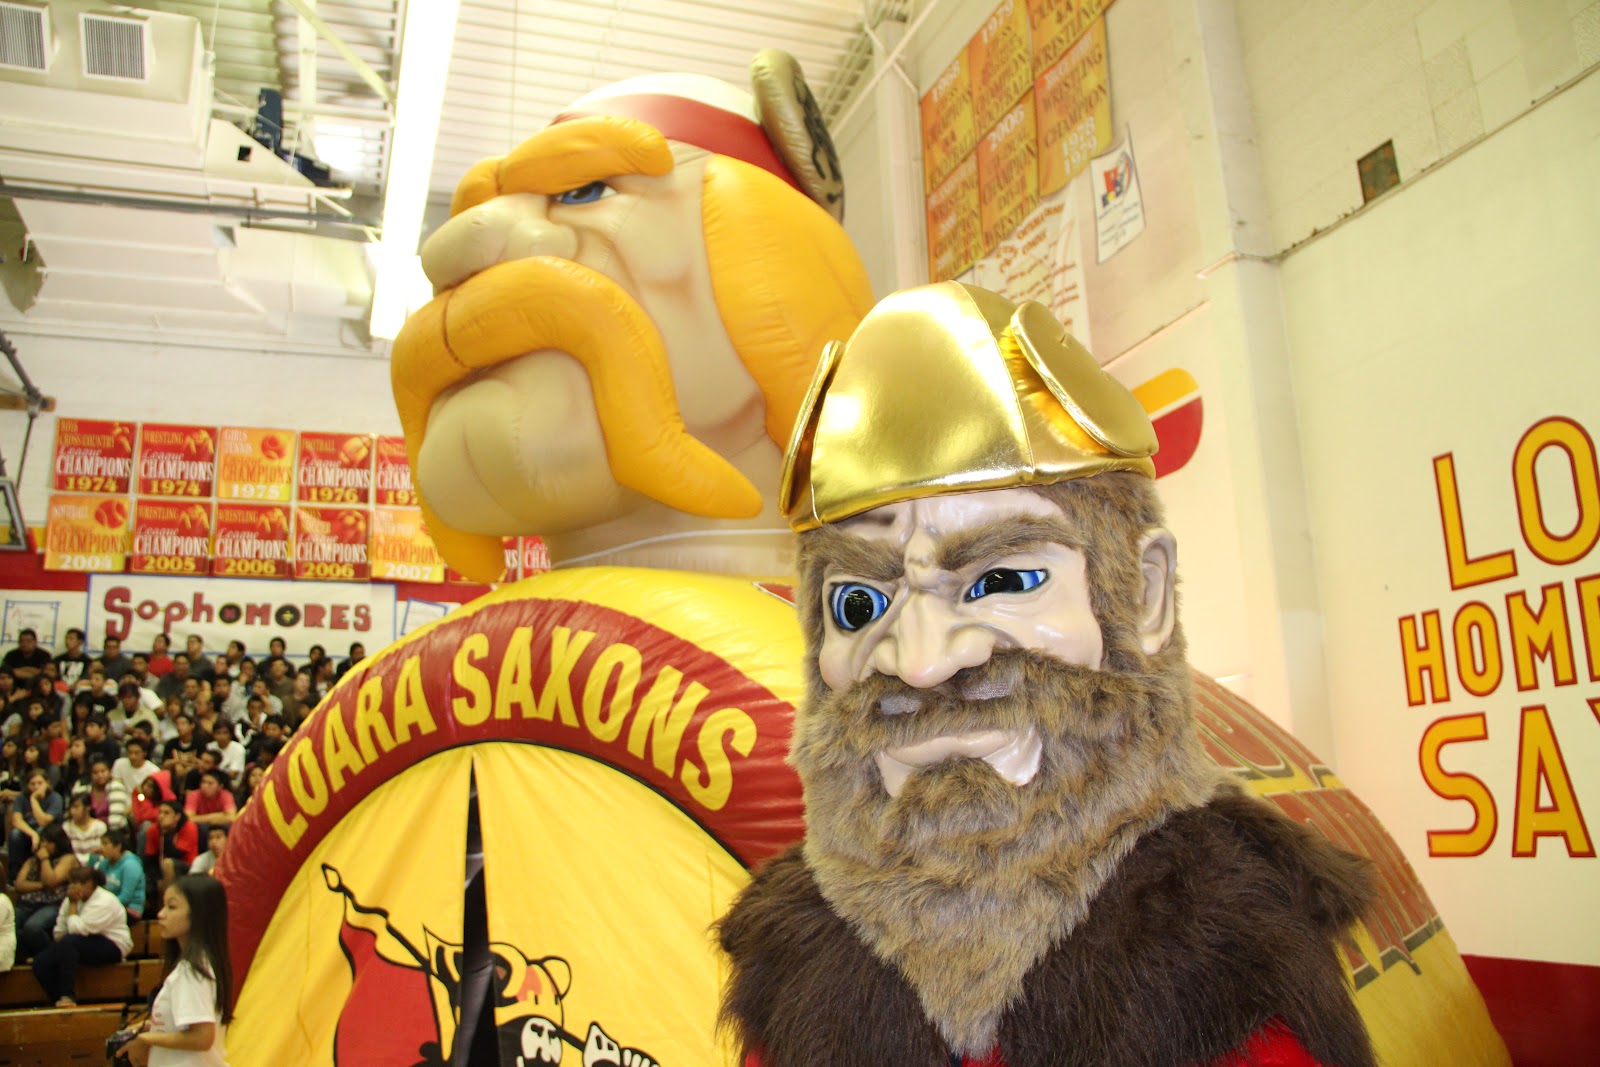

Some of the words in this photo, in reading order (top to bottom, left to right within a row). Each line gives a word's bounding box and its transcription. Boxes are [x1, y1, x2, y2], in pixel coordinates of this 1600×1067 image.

[1062, 116, 1096, 158] 1978
[58, 433, 81, 446] CROSS
[82, 435, 115, 448] COUNTRY
[144, 430, 184, 444] WRESTLING
[223, 428, 248, 442] GIRLS
[58, 445, 102, 456] League
[142, 449, 184, 460] League
[56, 455, 132, 478] CHAMPIONS
[140, 459, 214, 481] CHAMPIONS
[222, 463, 292, 483] CHAMPIONS
[66, 476, 118, 492] 1974
[300, 466, 370, 488] CHAMPIONS
[150, 480, 201, 496] 1974
[230, 484, 281, 499] 1975
[309, 486, 359, 503] 1976
[138, 505, 178, 520] WRESTLING
[218, 509, 258, 524] WRESTLING
[136, 524, 180, 536] League
[216, 527, 259, 540] League
[50, 533, 126, 554] CHAMPIONS
[134, 534, 209, 556] CHAMPIONS
[216, 538, 290, 560] CHAMPIONS
[296, 541, 368, 564] CHAMPIONS
[58, 554, 113, 570] 2004
[143, 556, 197, 571] 2005
[224, 558, 276, 574] 2006
[303, 562, 355, 578] 2006
[384, 562, 434, 580] 2007
[264, 655, 437, 851] LOARA
[452, 625, 757, 812] SAXONS
